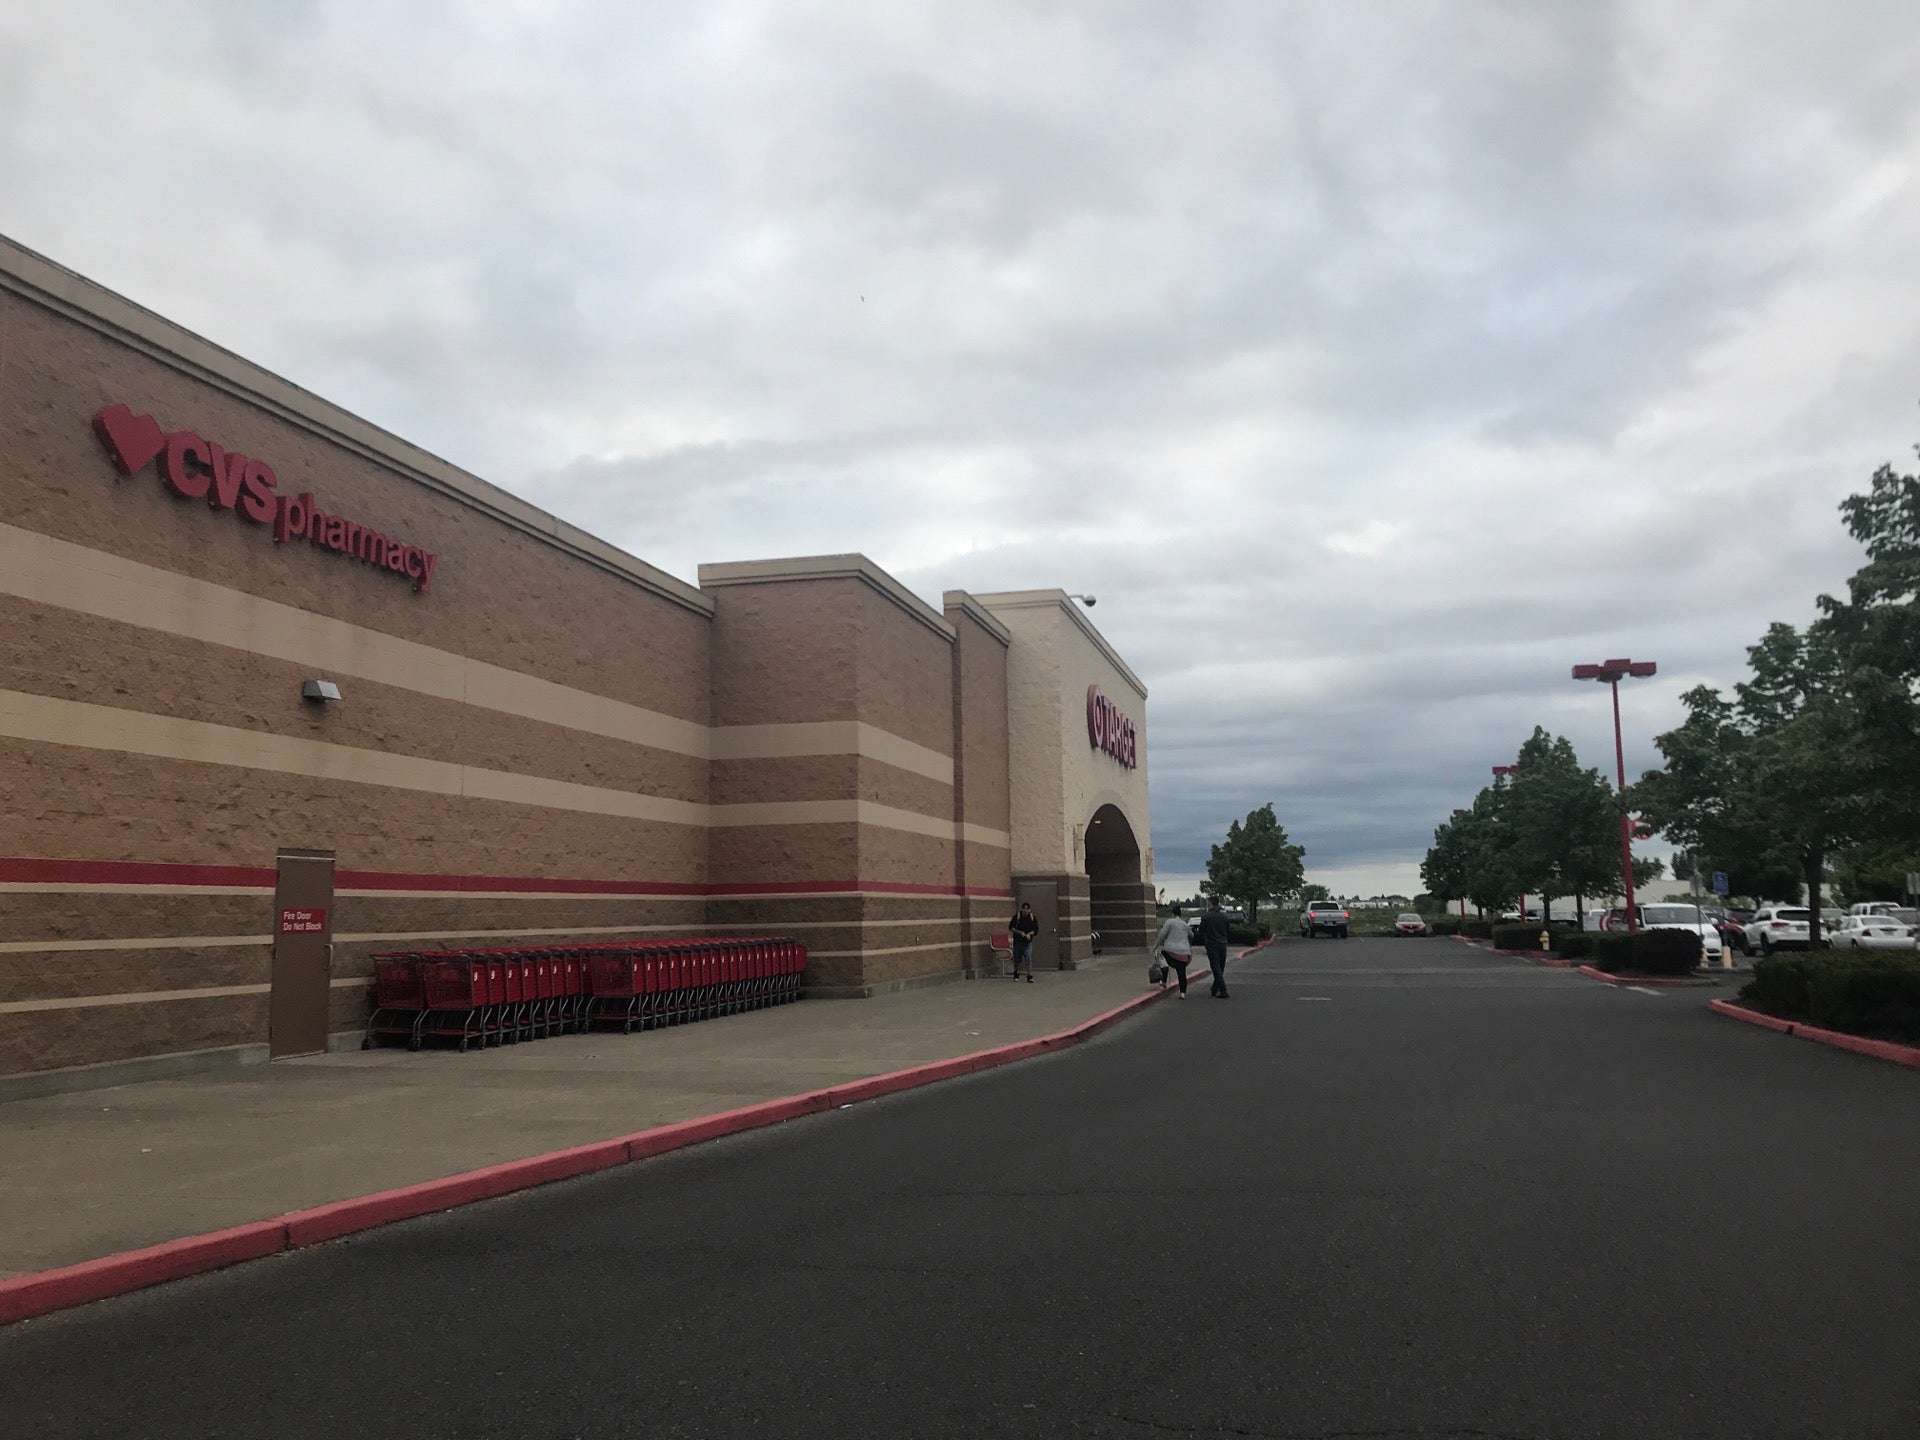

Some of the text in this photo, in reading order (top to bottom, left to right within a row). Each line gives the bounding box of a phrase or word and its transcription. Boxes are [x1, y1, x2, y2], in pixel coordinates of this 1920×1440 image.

[157, 430, 437, 592] CVS pharmacy
[1101, 695, 1137, 769] TARGET
[283, 911, 312, 920] Fire Door
[283, 922, 322, 931] Do Not Block
